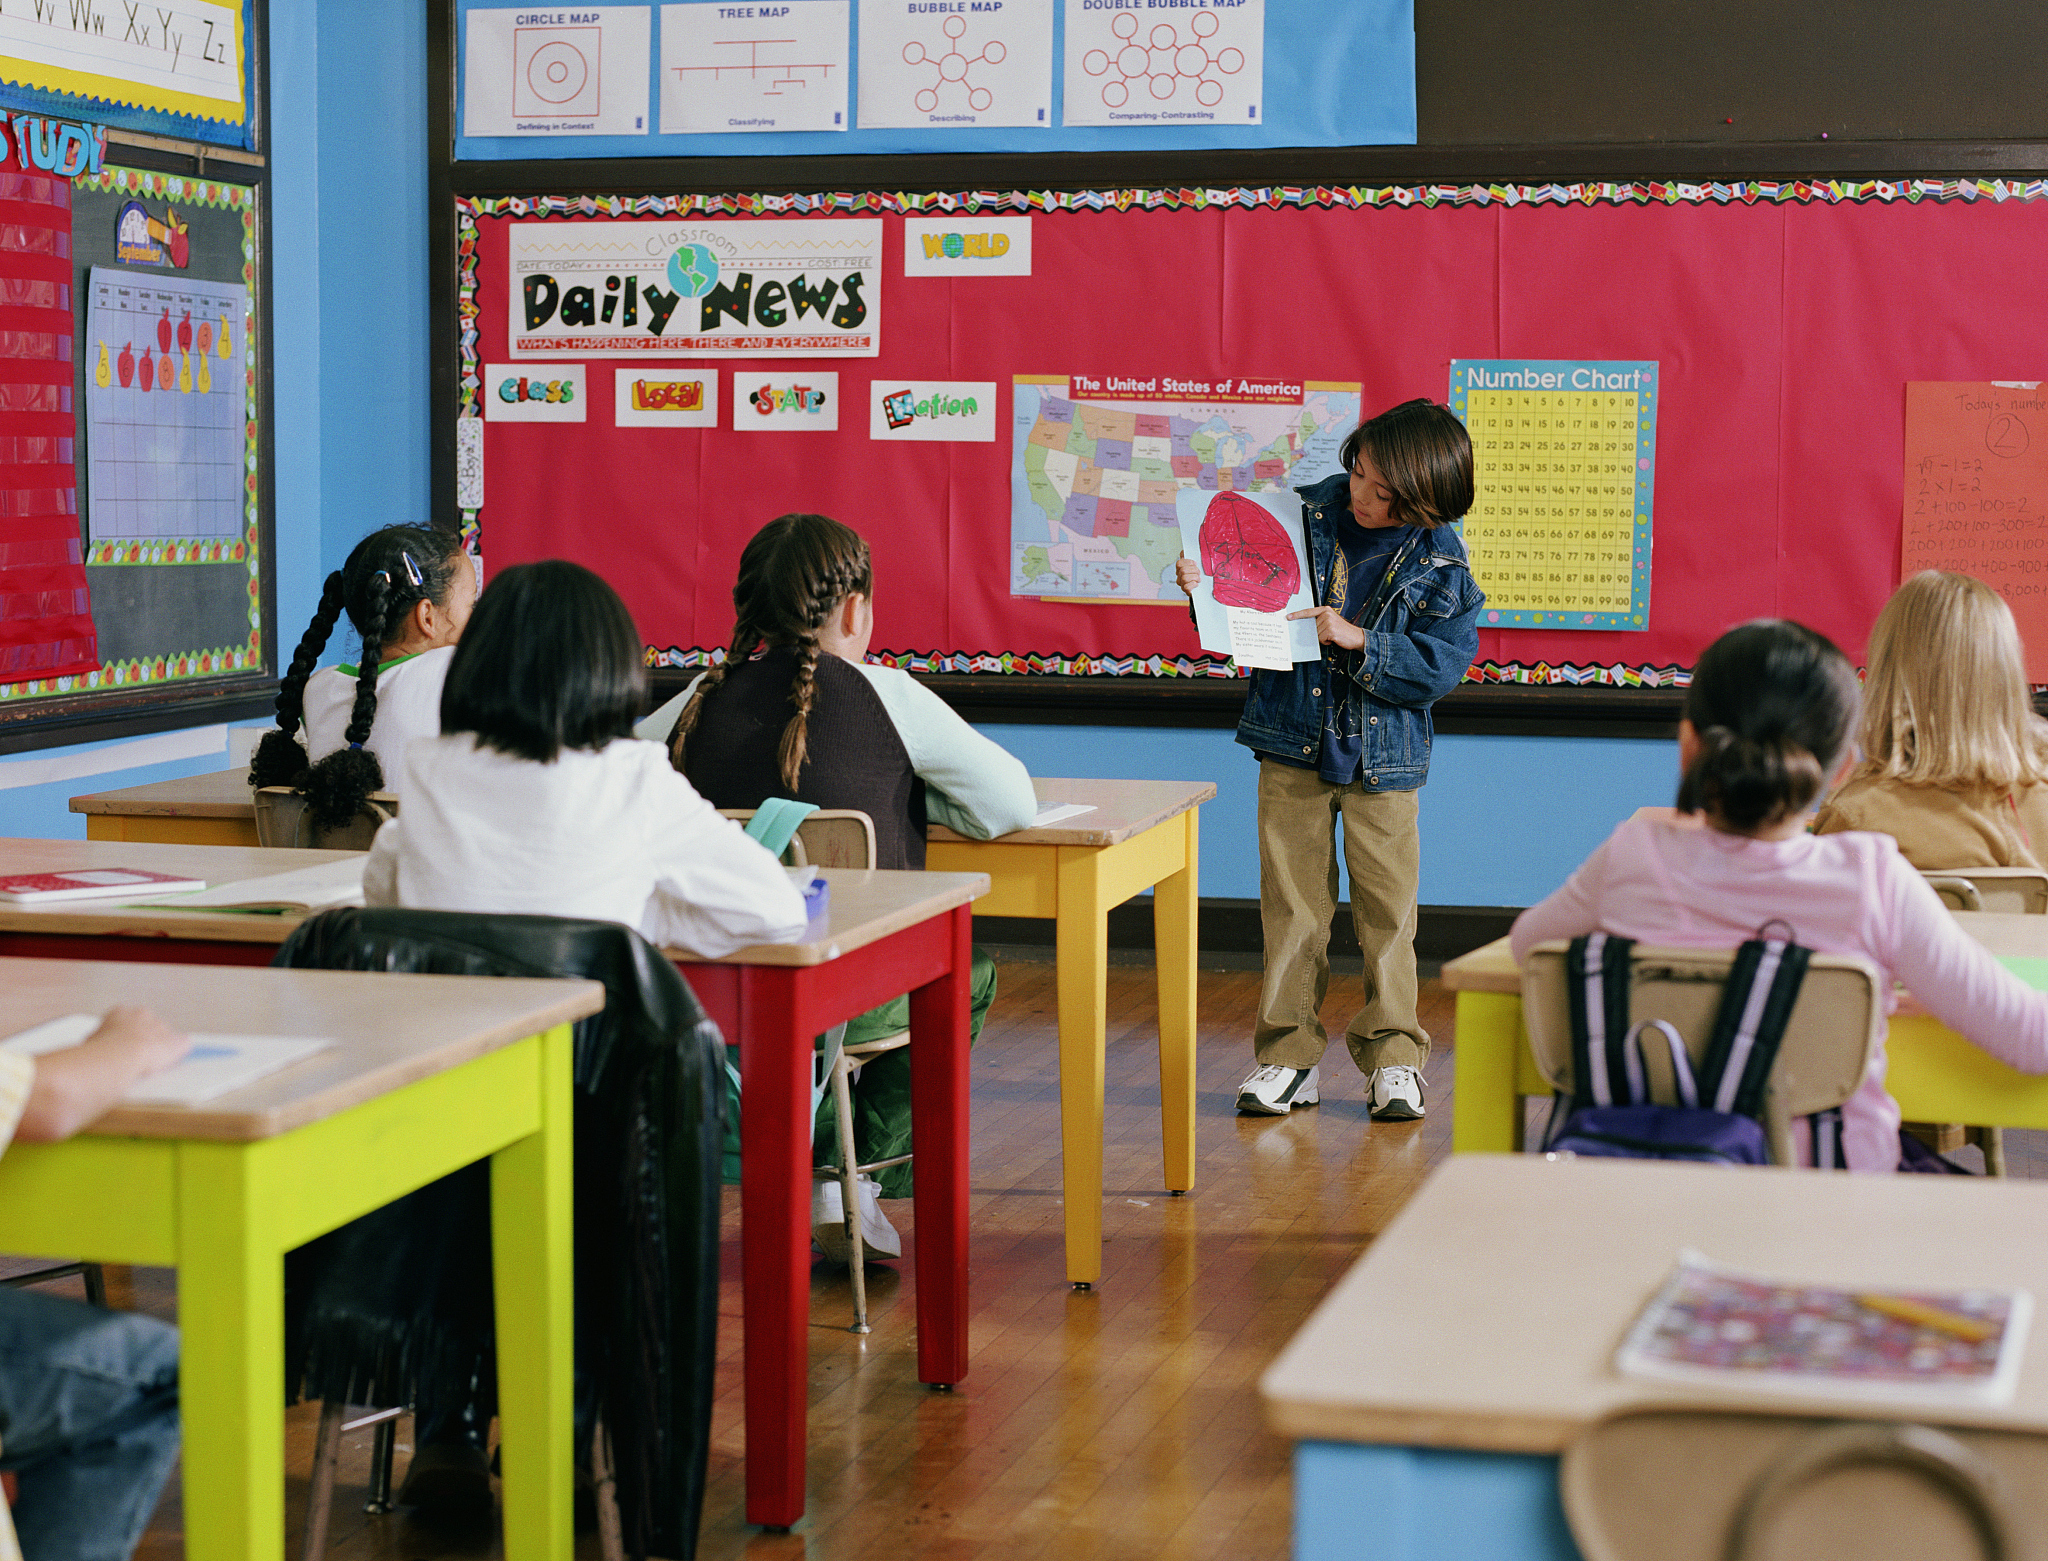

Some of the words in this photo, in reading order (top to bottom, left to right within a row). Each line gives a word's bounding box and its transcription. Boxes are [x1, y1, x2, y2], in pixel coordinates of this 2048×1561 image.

[907, 2, 968, 13] BUBBLE
[971, 1, 1002, 12] MAP
[1083, 0, 1143, 10] DOUBLE
[1148, 0, 1208, 8] BUBBLE
[718, 8, 756, 18] TREE
[759, 7, 790, 17] MAP
[516, 14, 566, 25] CIRCLE
[570, 13, 600, 24] MAP
[123, 0, 149, 47] Xx
[157, 8, 182, 73] Yy
[203, 20, 225, 64] Zz
[728, 118, 775, 127] Classifying
[929, 114, 976, 123] Describing
[516, 123, 551, 132] Defining
[645, 227, 738, 257] Classroom
[921, 233, 1010, 260] WORLD
[547, 260, 585, 270] TODAY
[844, 258, 871, 268] FREE
[523, 274, 680, 337] Daily
[700, 272, 867, 333] News
[518, 338, 570, 349] WHAT'S
[572, 338, 647, 349] HAPPENING
[650, 338, 687, 349] HERE
[691, 337, 736, 348] THERE
[741, 337, 768, 348] AND
[772, 336, 867, 348] EVERYWHERE
[100, 358, 108, 379] 5
[123, 358, 129, 378] 6
[1467, 367, 1565, 388] Number
[1571, 369, 1641, 390] Chart
[499, 376, 574, 404] Class
[1073, 376, 1101, 391] The
[1107, 377, 1156, 391] United
[1162, 378, 1211, 393] States
[1216, 379, 1233, 394] of
[1237, 380, 1301, 396] America
[1490, 397, 1495, 406] 2
[1507, 398, 1512, 407] 3
[1524, 397, 1529, 406] 4
[1541, 398, 1546, 407] 5
[1558, 398, 1564, 407] 6
[1576, 398, 1581, 407] 7
[1592, 398, 1597, 407] 8
[1609, 398, 1615, 407] 9
[1625, 398, 1634, 407] 10
[1955, 390, 2000, 418] Today's
[884, 389, 978, 429] Nation
[1472, 418, 1478, 427] 11
[1488, 419, 1496, 428] 12
[1505, 420, 1513, 429] 13
[1522, 419, 1530, 428] 14
[1539, 420, 1547, 429] 15
[1556, 420, 1565, 429] 16
[1573, 420, 1581, 429] 17
[1590, 420, 1598, 429] 18
[1607, 420, 1616, 429] 19
[1623, 421, 1633, 430] 20
[1994, 417, 2016, 449] 2
[1486, 441, 1497, 450] 22
[1503, 441, 1514, 450] 23
[1520, 441, 1531, 450] 24
[1538, 442, 1548, 451] 25
[1554, 442, 1565, 451] 26
[1571, 442, 1582, 451] 27
[1589, 442, 1599, 451] 28
[1605, 443, 1616, 452] 29
[1623, 443, 1633, 452] 30
[1486, 463, 1496, 472] 32
[1503, 463, 1513, 472] 33
[1519, 463, 1530, 472] 34
[1537, 464, 1547, 473] 35
[1553, 464, 1565, 473] 36
[1571, 464, 1581, 473] 37
[1588, 465, 1598, 474] 38
[1605, 465, 1616, 474] 39
[1621, 465, 1632, 474] 40
[1485, 485, 1495, 494] 42
[1501, 485, 1512, 494] 43
[1518, 485, 1529, 494] 44
[1535, 486, 1546, 495] 45
[1552, 486, 1564, 495] 46
[1569, 485, 1580, 494] 47
[1587, 486, 1598, 495] 48
[1604, 486, 1615, 495] 49
[1621, 487, 1631, 496] 50
[1484, 507, 1495, 516] 52
[1501, 507, 1512, 516] 53
[1518, 507, 1529, 516] 54
[1535, 507, 1545, 516] 55
[1552, 508, 1563, 517] 56
[1569, 508, 1579, 517] 57
[1586, 508, 1597, 517] 58
[1603, 509, 1614, 518] 59
[1620, 509, 1631, 518] 60
